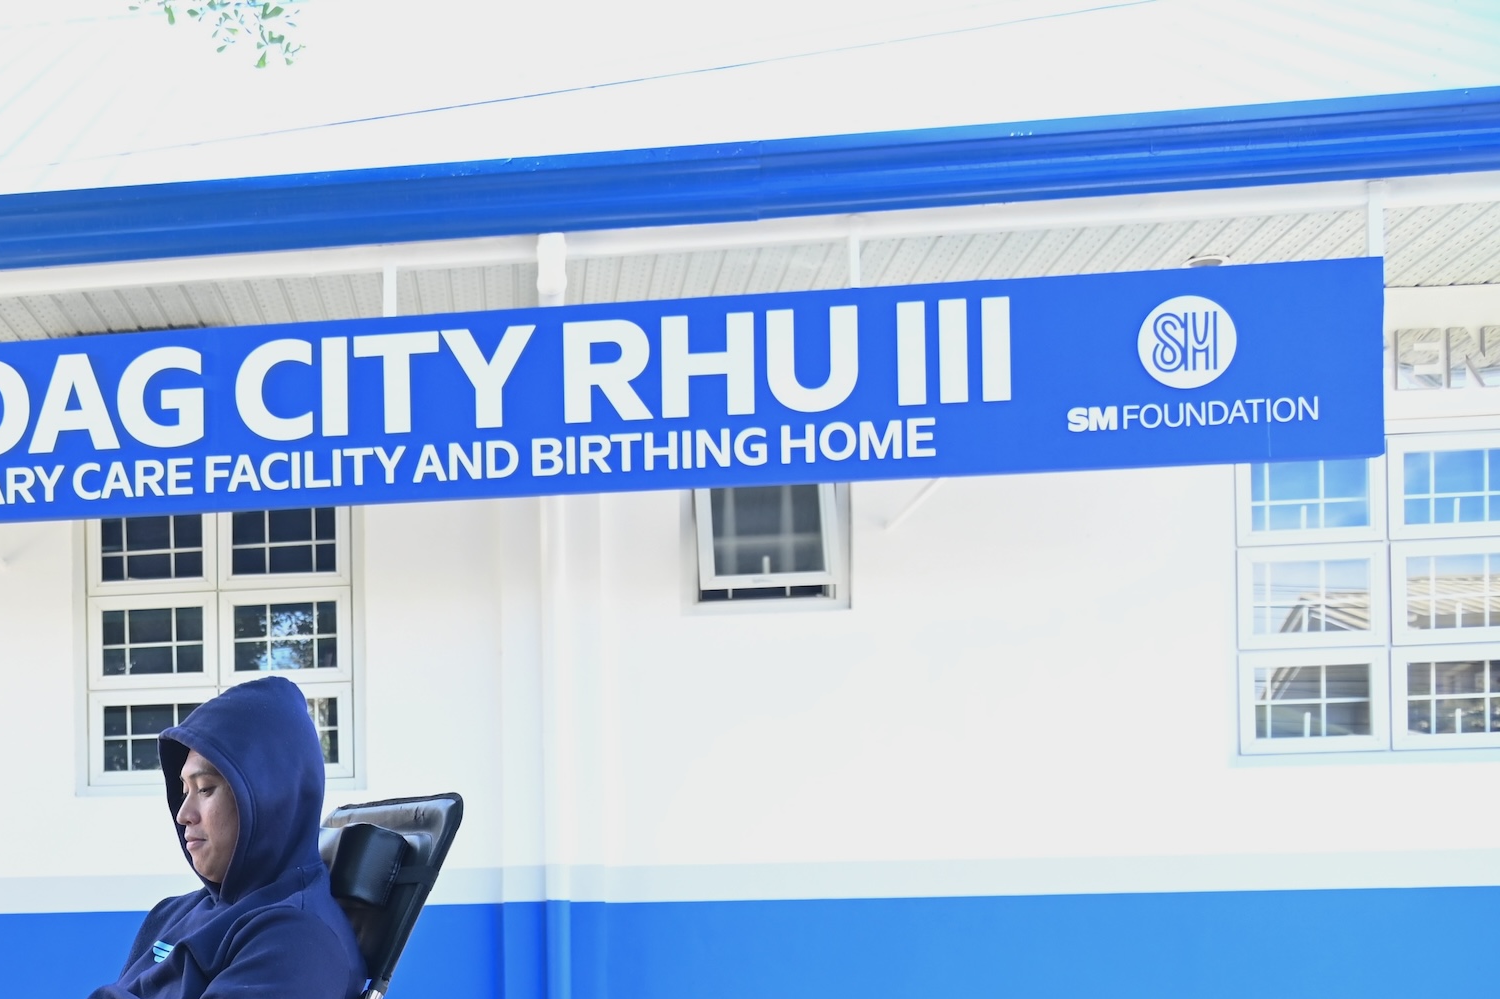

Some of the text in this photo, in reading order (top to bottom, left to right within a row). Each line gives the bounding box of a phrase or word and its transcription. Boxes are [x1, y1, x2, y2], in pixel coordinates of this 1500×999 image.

[236, 325, 535, 440] CITY
[563, 306, 858, 423] RHU
[897, 297, 1011, 405] III
[1067, 396, 1319, 432] SM FOUNDATION
[73, 458, 193, 499] CARE
[206, 446, 405, 492] FACILITY
[413, 441, 518, 482] AND
[532, 428, 767, 476] BIRTHING
[781, 418, 936, 463] HOME
